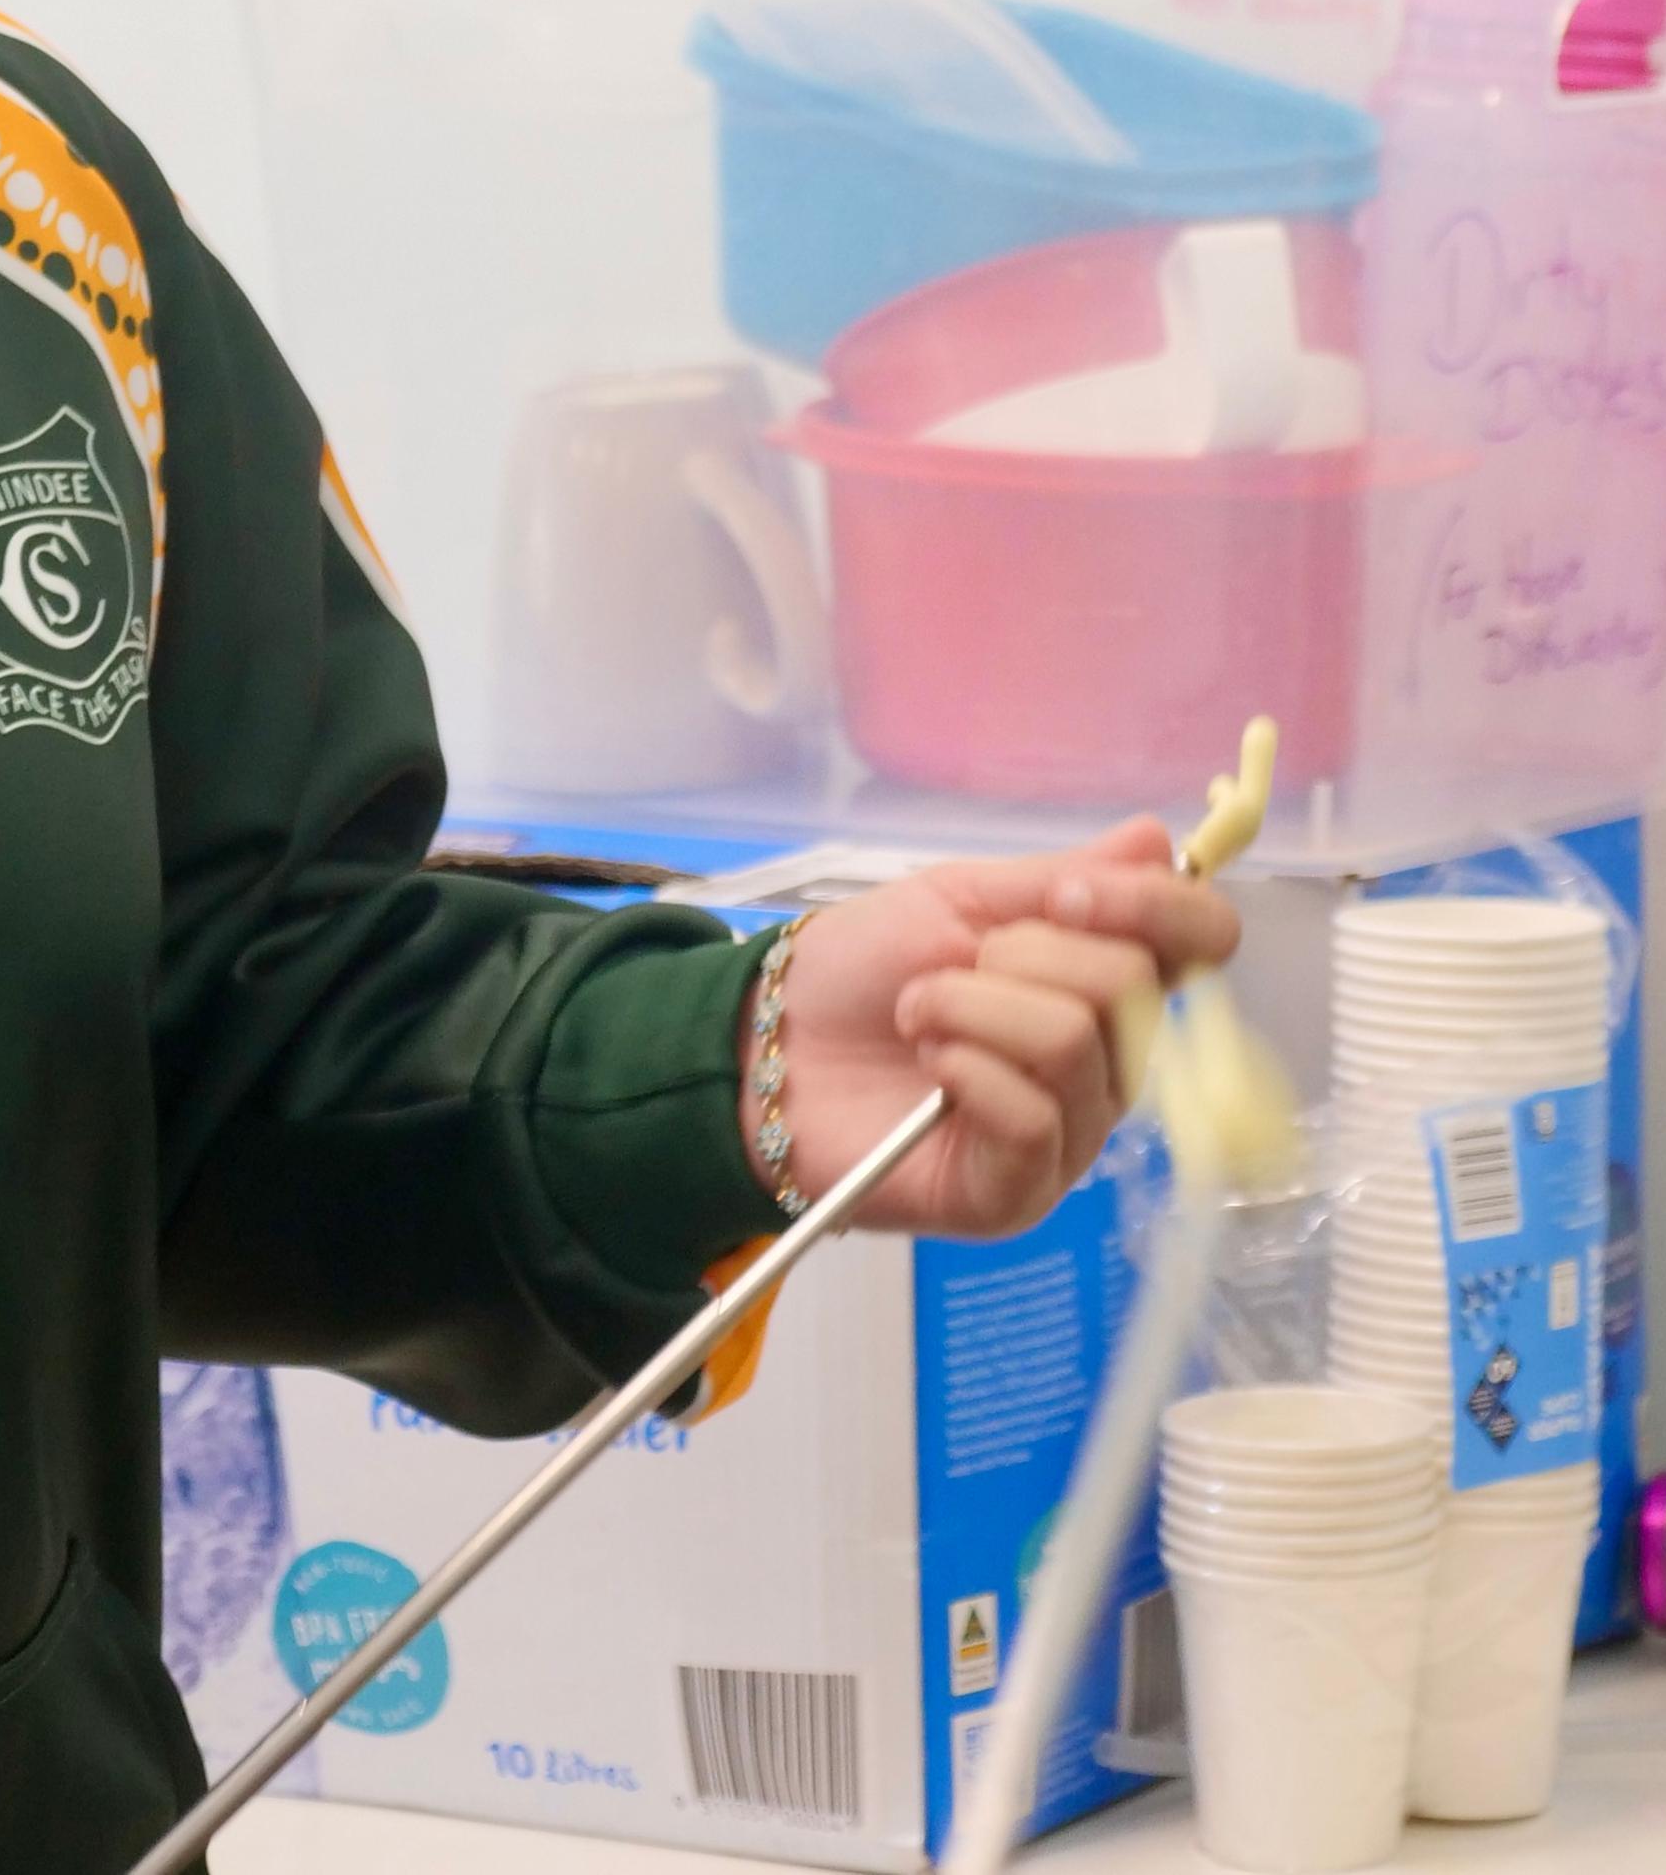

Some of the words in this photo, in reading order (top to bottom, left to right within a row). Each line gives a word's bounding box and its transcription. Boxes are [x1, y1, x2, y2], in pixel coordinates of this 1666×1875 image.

[70, 683, 117, 728] THE
[487, 1737, 535, 1781] 10
[543, 1749, 639, 1793] Litres
